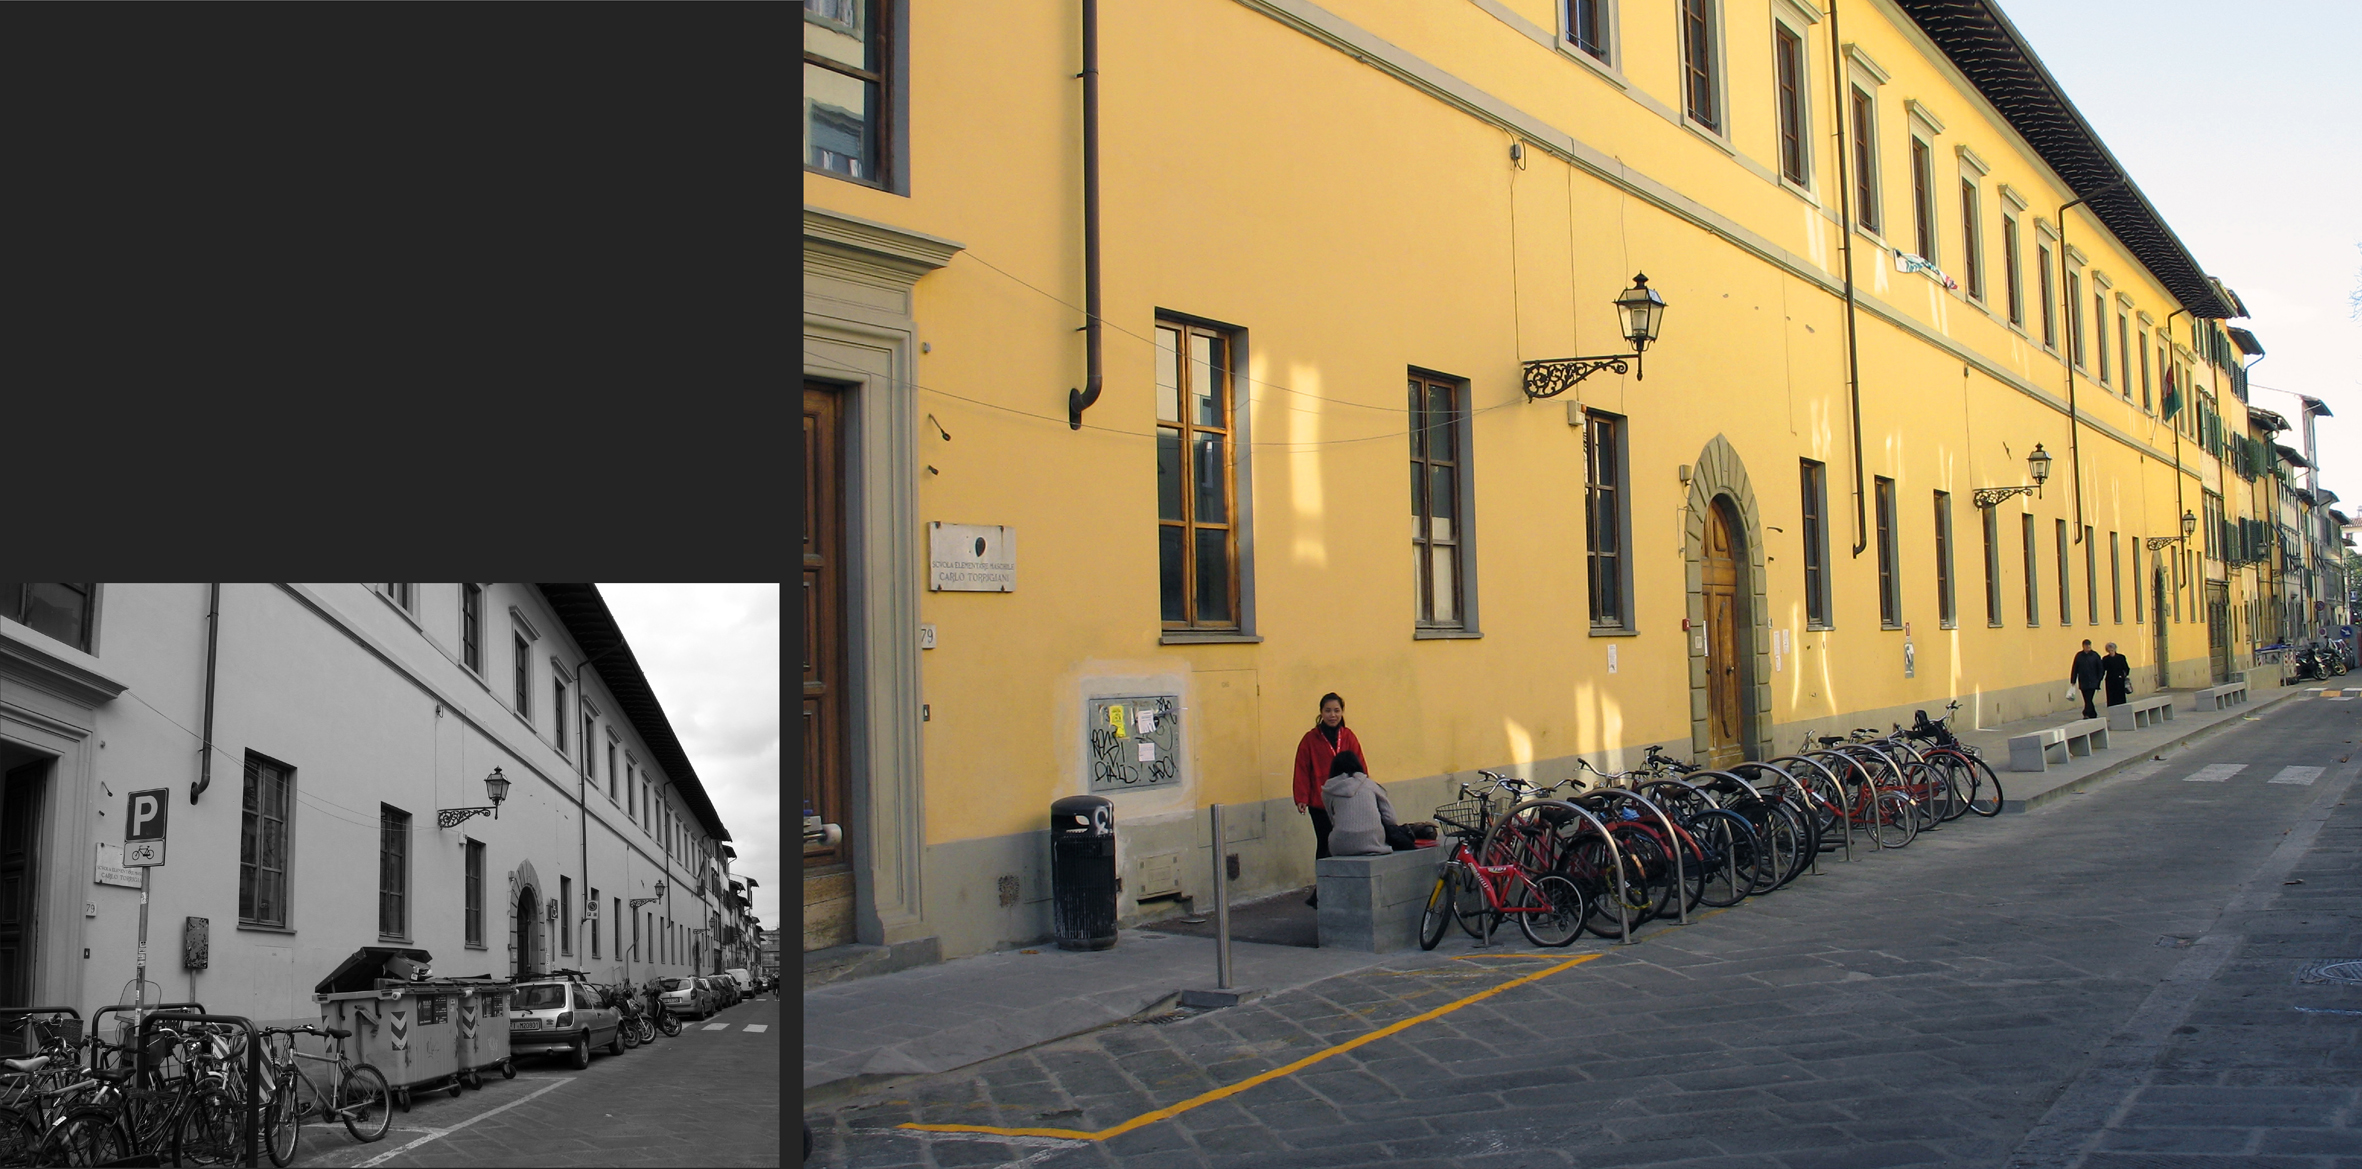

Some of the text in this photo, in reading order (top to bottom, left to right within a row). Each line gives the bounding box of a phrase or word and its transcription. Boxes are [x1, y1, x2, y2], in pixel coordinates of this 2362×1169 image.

[939, 572, 965, 582] CARLO
[920, 628, 934, 644] 79
[133, 795, 159, 837] P
[101, 872, 142, 883] CARLO TORRIGI
[86, 903, 96, 914] 79
